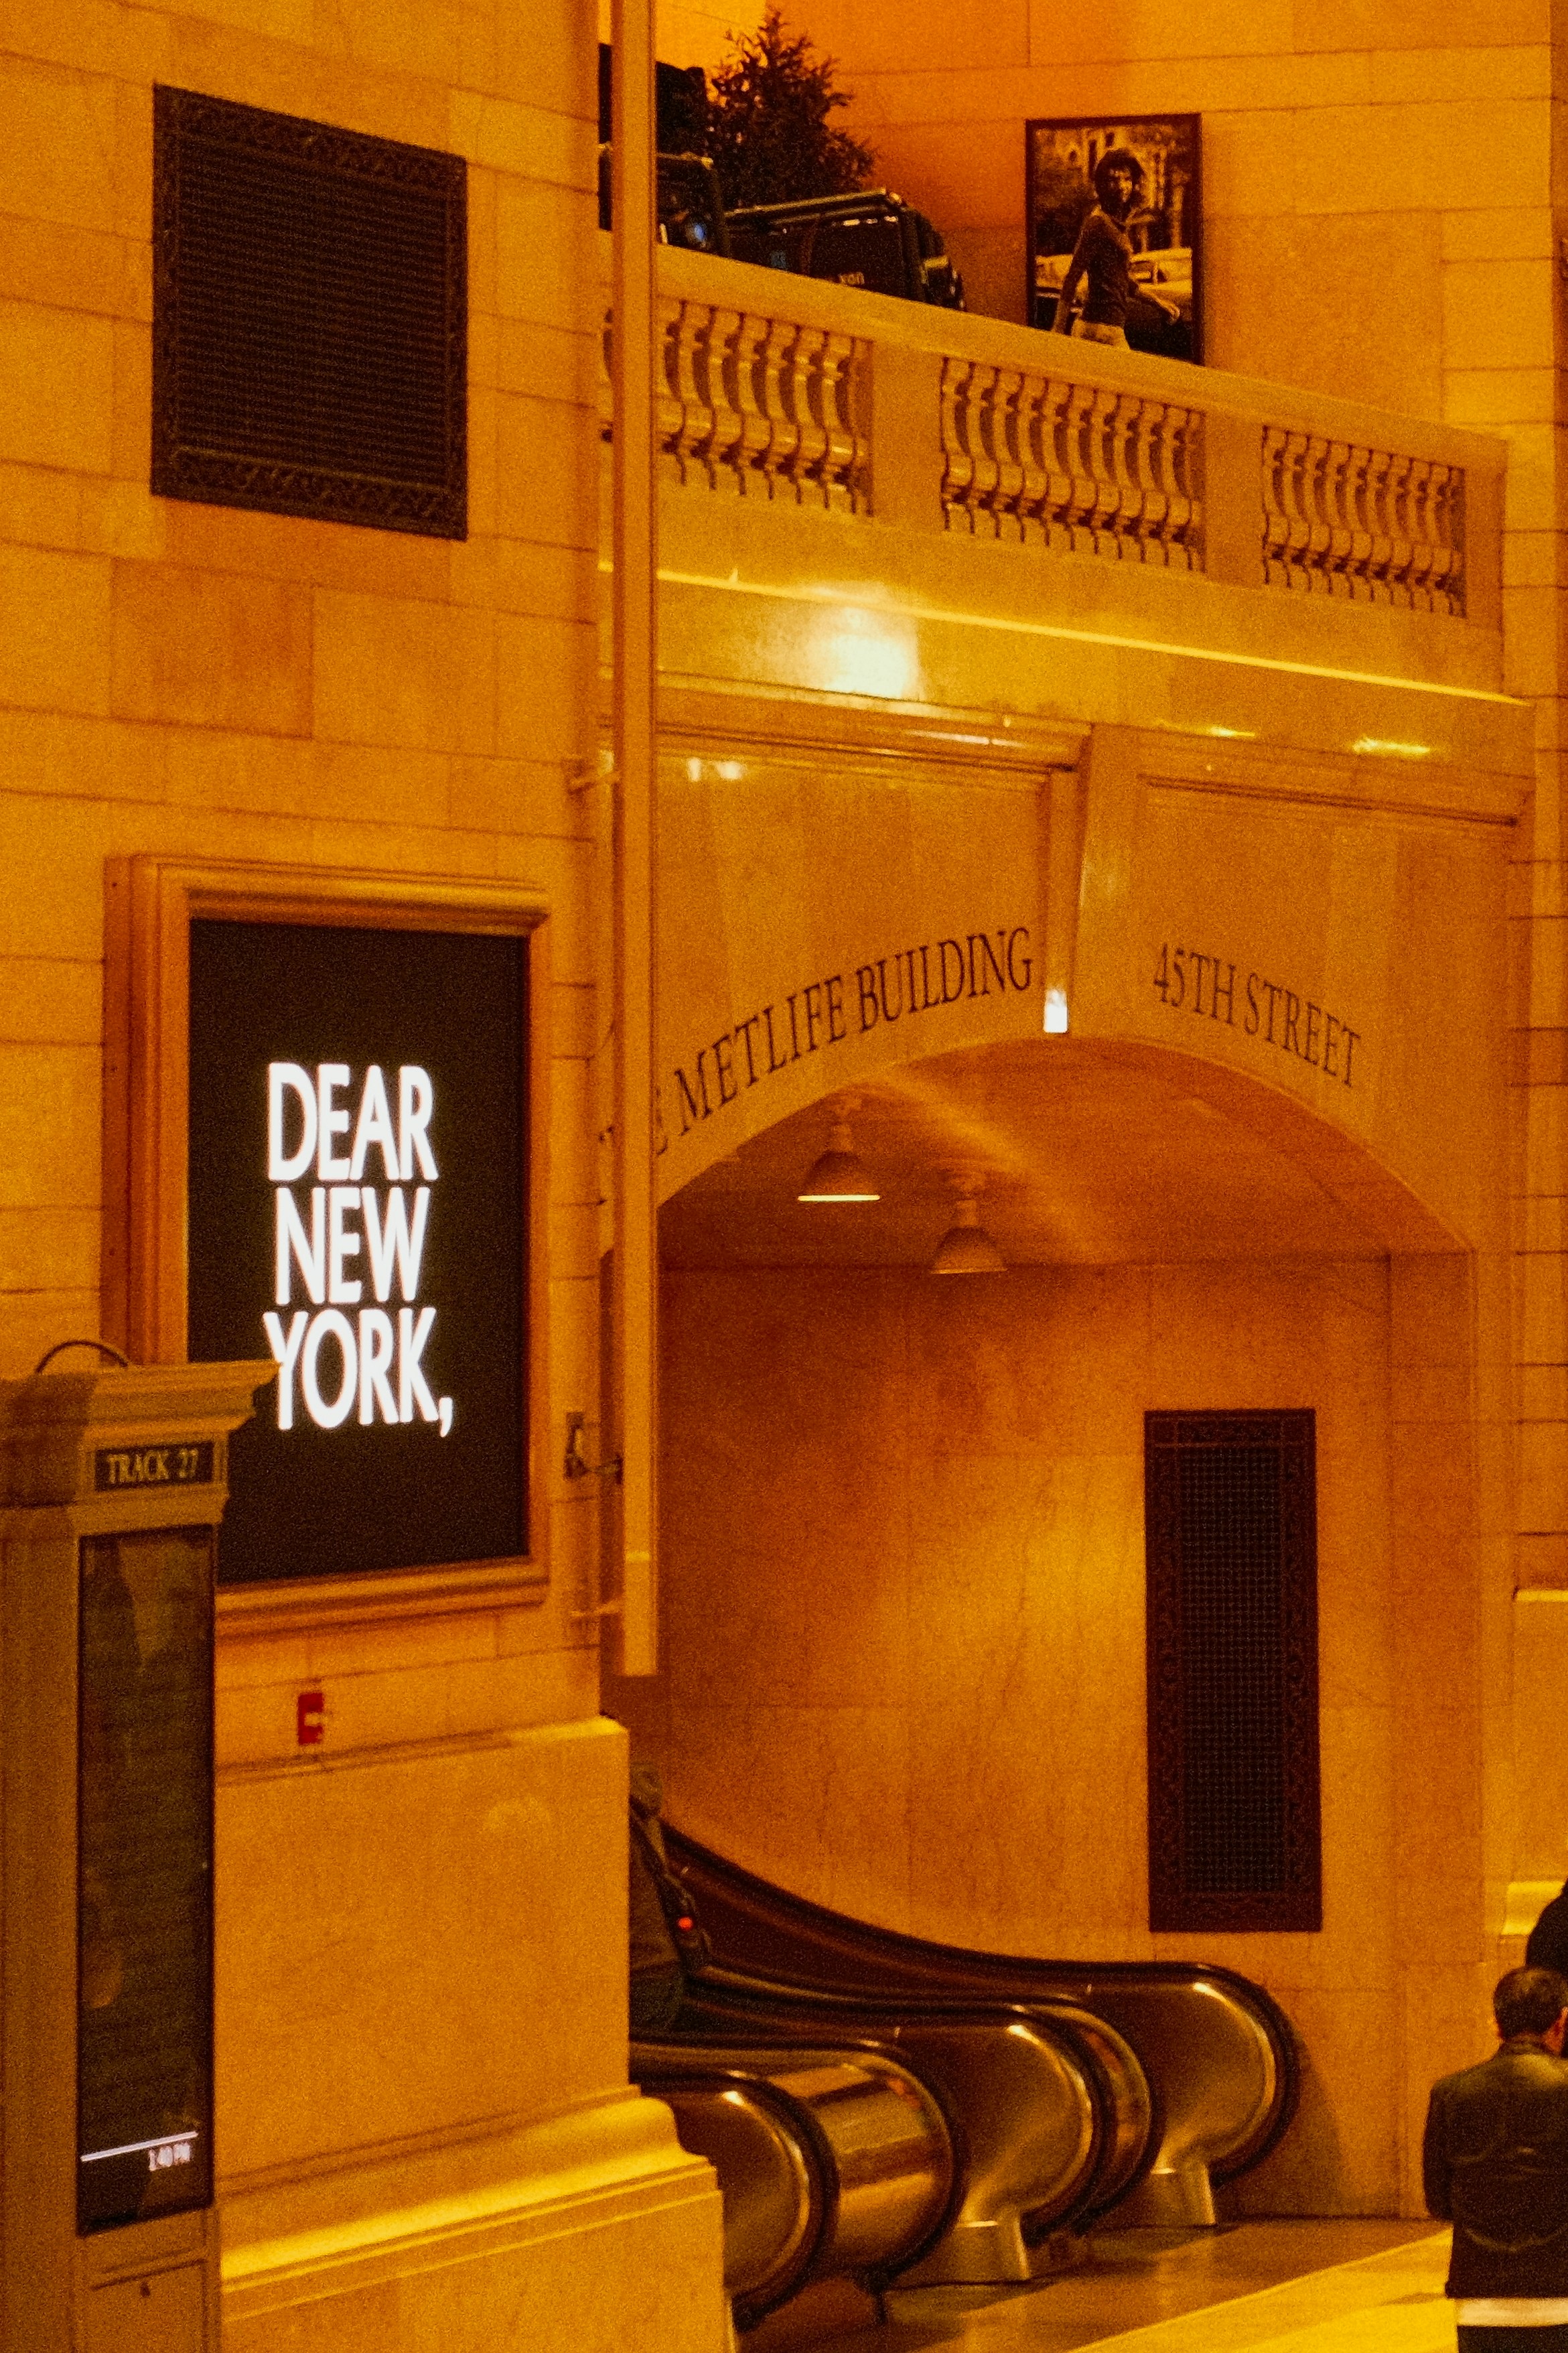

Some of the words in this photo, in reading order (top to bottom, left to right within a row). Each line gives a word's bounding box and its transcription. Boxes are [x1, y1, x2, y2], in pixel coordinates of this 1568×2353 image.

[673, 974, 847, 1137] METLIFE
[855, 927, 1032, 1034] BUILDING
[1153, 943, 1235, 1025] 45TH
[1244, 971, 1362, 1087] STREET
[268, 1061, 439, 1181] DEAR
[275, 1187, 431, 1305] NEW
[263, 1306, 454, 1438] YORK,
[106, 1450, 169, 1485] TRACK
